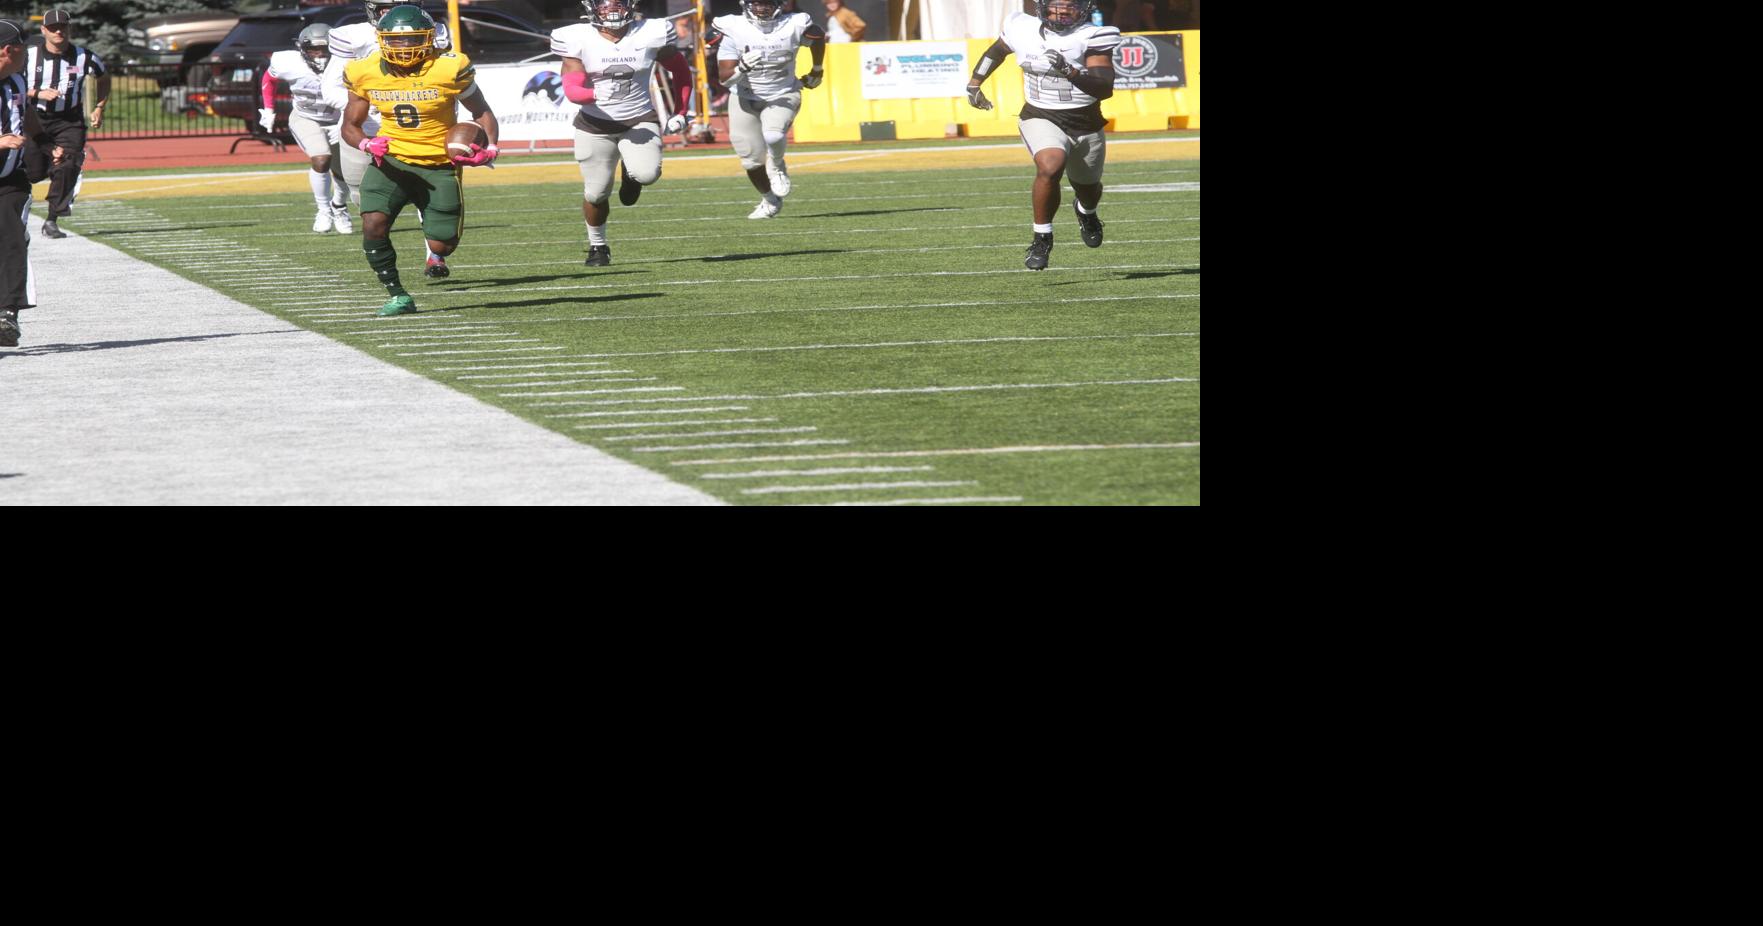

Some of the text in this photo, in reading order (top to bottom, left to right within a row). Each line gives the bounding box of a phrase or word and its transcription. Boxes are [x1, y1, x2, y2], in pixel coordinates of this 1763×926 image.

[1120, 46, 1144, 67] JJ
[1019, 61, 1074, 101] 14
[369, 88, 439, 102] YELLOWJACKETS
[393, 103, 420, 129] 8
